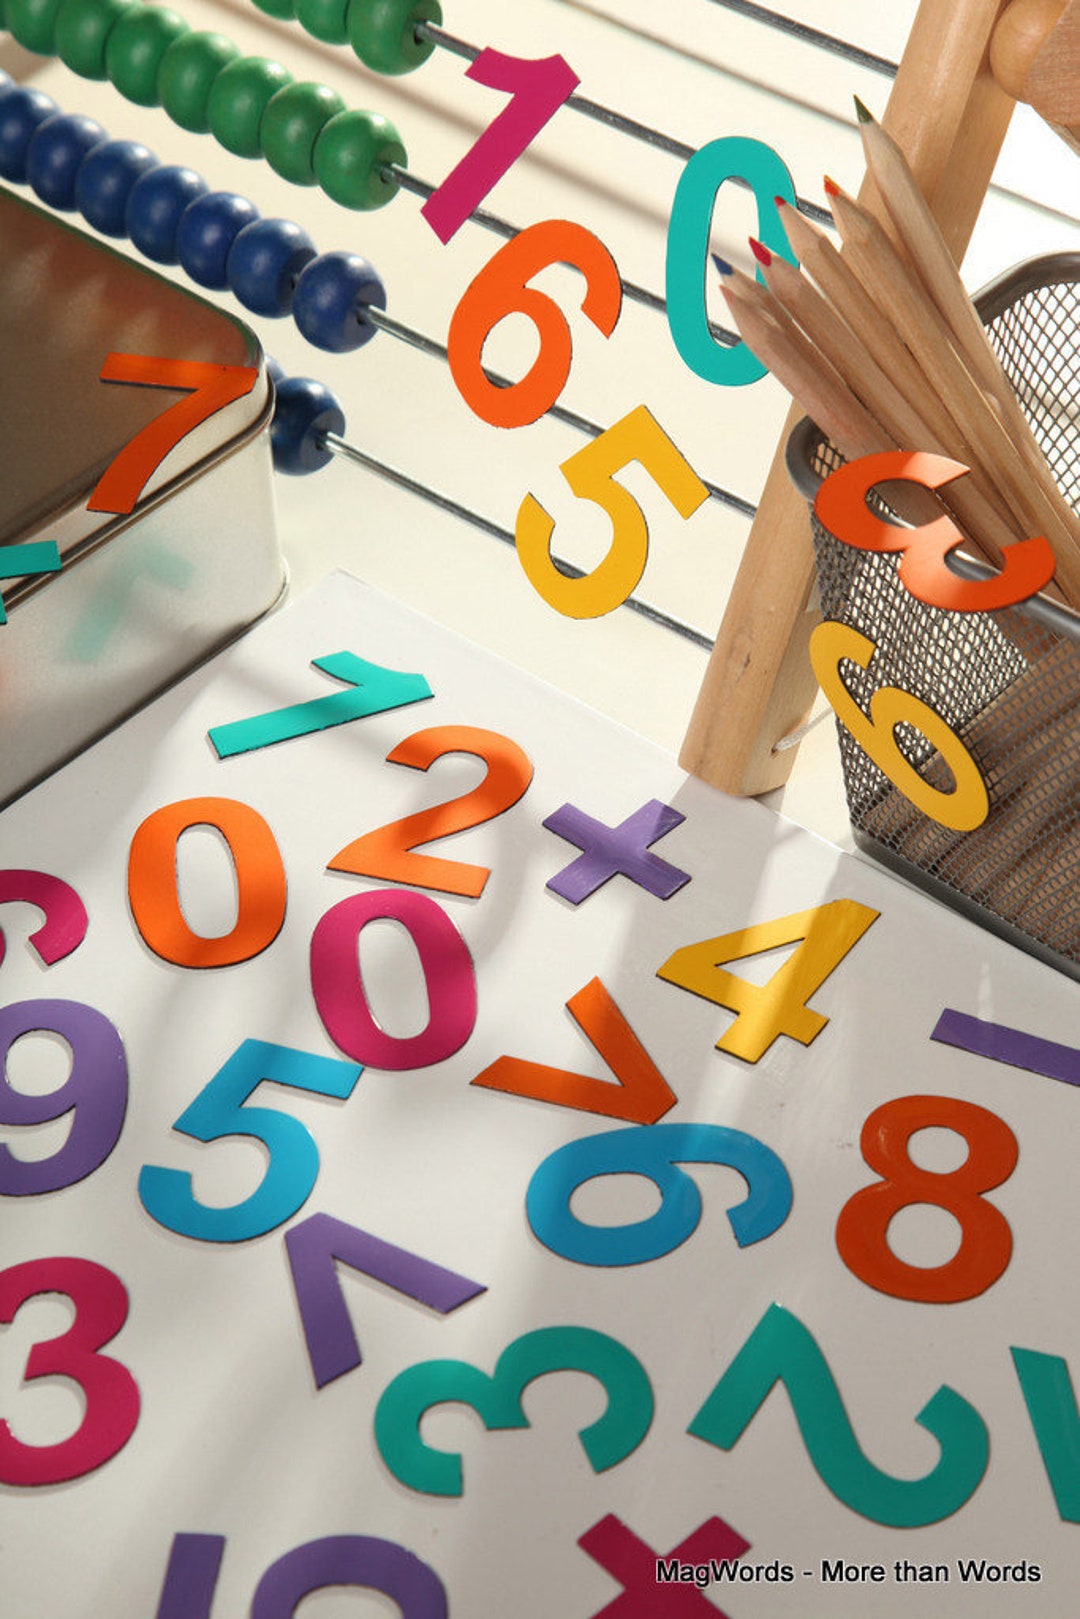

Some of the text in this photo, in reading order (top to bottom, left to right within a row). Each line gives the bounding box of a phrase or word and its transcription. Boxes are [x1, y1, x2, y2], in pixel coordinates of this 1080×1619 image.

[420, 46, 581, 245] 1
[448, 219, 623, 429] 6
[87, 352, 258, 515] 7
[515, 404, 710, 619] 5
[815, 451, 1056, 612] 3
[208, 650, 435, 759] 1
[128, 796, 287, 969] 0
[327, 725, 534, 899] 2
[310, 888, 478, 1071] 0
[656, 899, 881, 1064] 4
[0, 999, 128, 1197] 9
[138, 1038, 364, 1243] 5
[835, 1095, 1019, 1304] 8
[0, 1257, 140, 1487] 3
[374, 1325, 655, 1498] 3
[686, 1301, 990, 1529] 2
